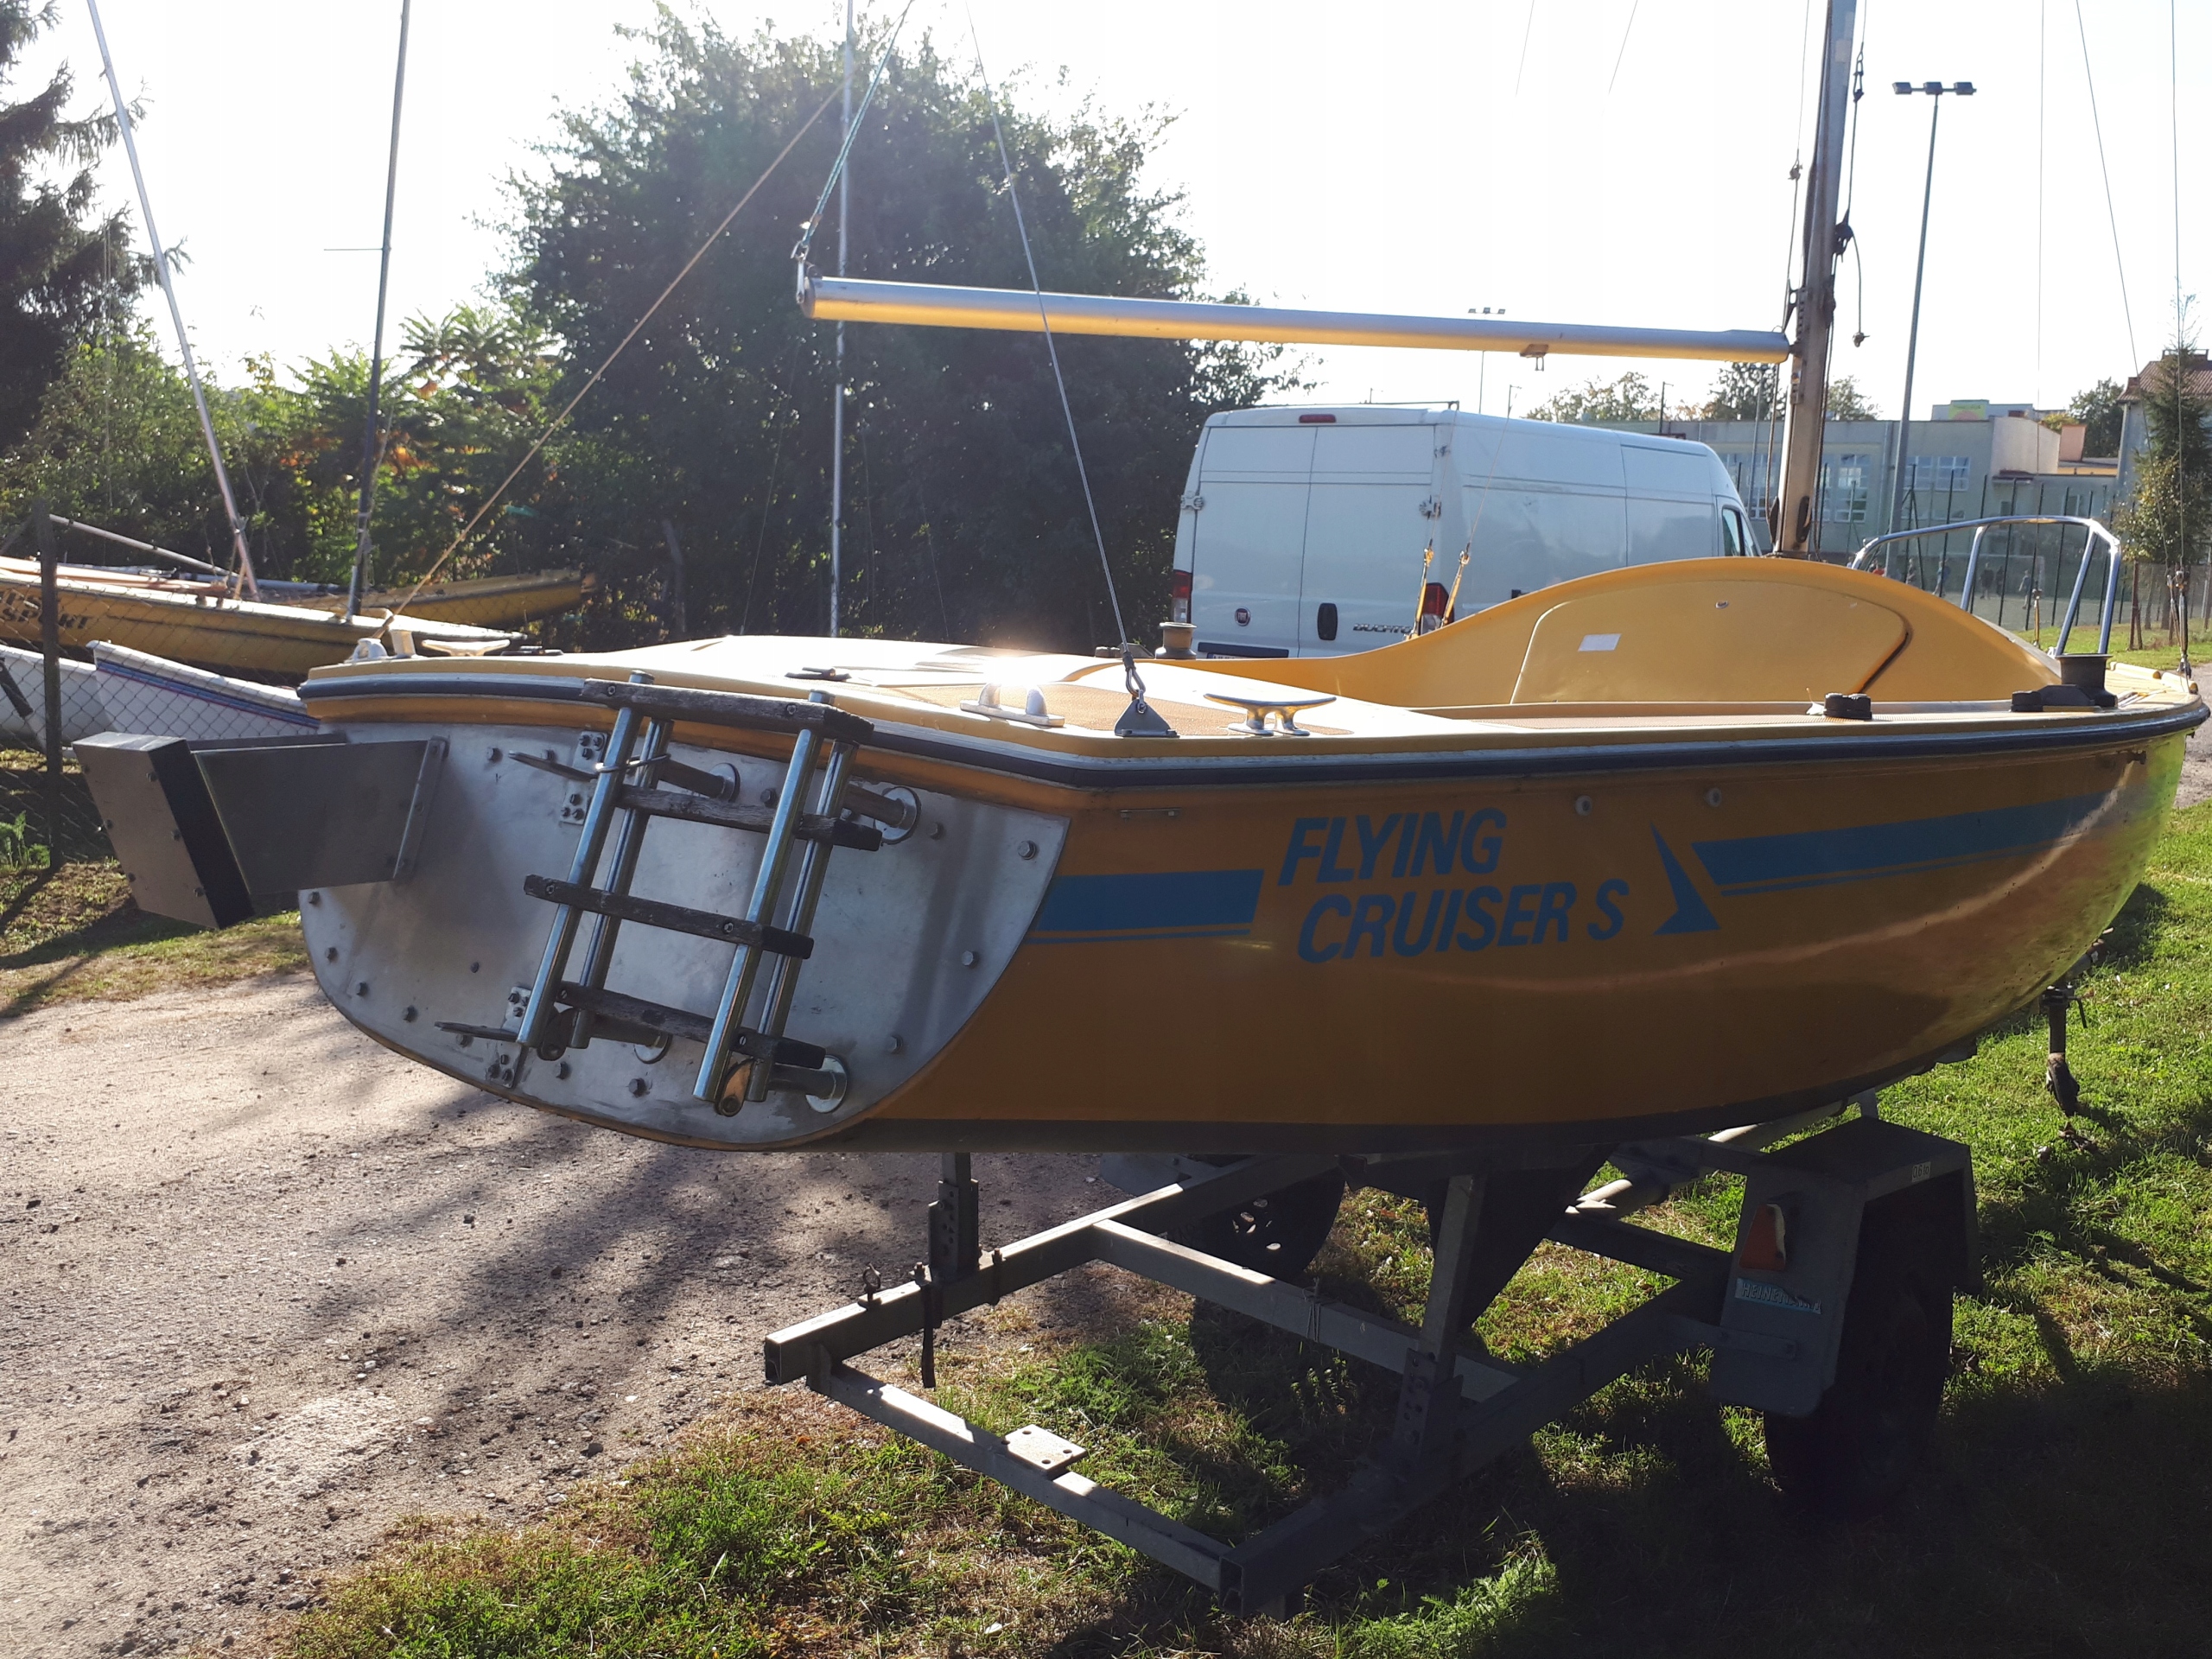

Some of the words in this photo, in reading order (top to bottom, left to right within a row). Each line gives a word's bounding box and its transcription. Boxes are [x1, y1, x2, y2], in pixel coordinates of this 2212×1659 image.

[1277, 808, 1507, 887] FLYING
[1298, 881, 1577, 963] CRUISER
[1587, 879, 1630, 941] S
